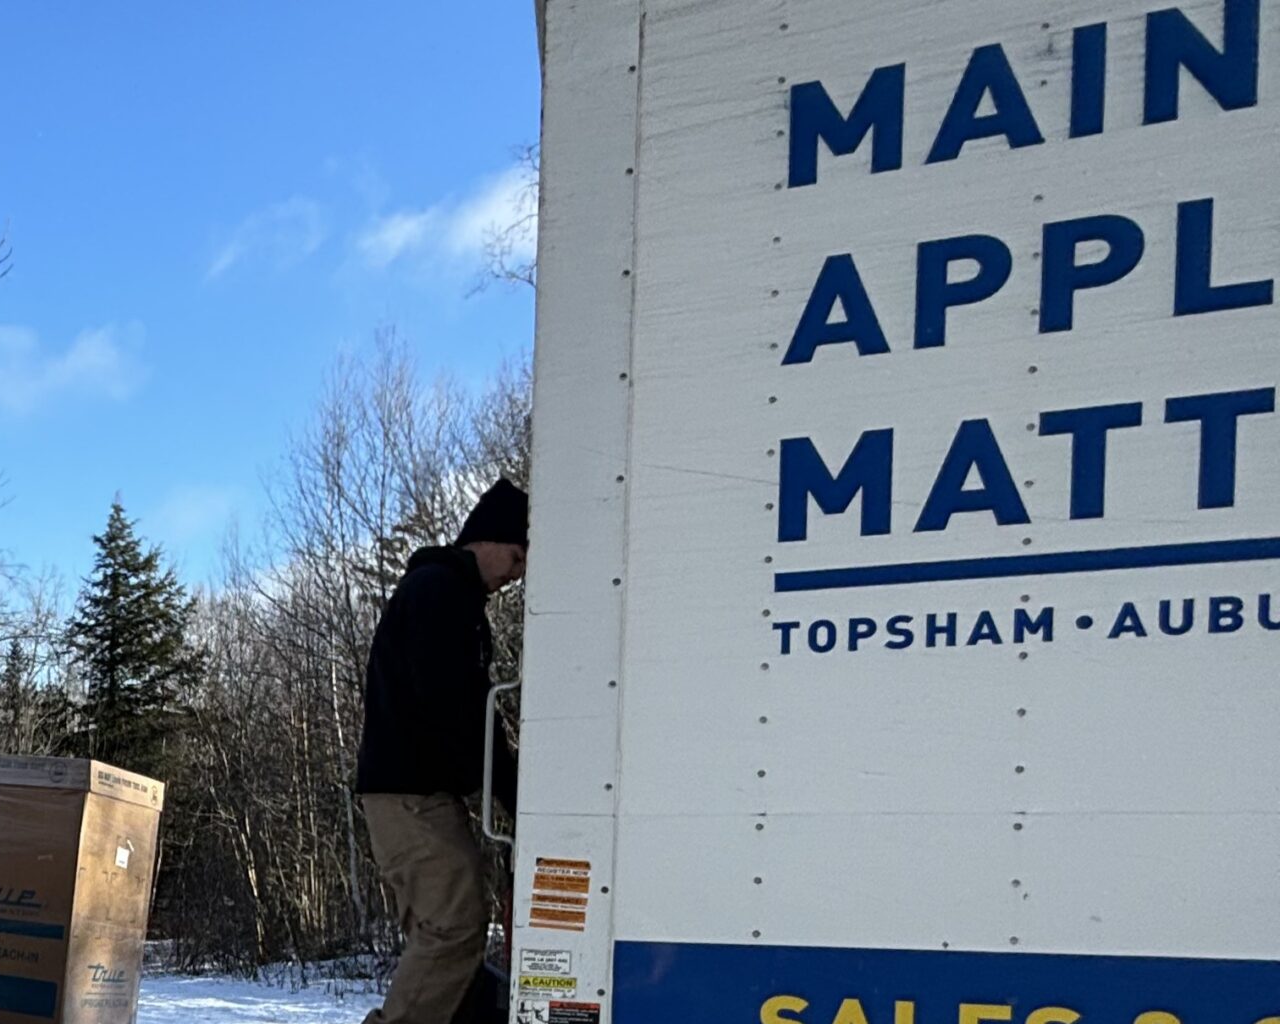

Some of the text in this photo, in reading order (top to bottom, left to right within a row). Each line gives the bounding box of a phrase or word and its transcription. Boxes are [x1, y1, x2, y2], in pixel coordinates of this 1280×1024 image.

[788, 0, 1260, 188] MAIN
[781, 198, 1274, 365] APPL
[777, 387, 1276, 542] MATT
[772, 607, 1054, 655] TOPSHAM
[532, 978, 573, 987] CAUTION
